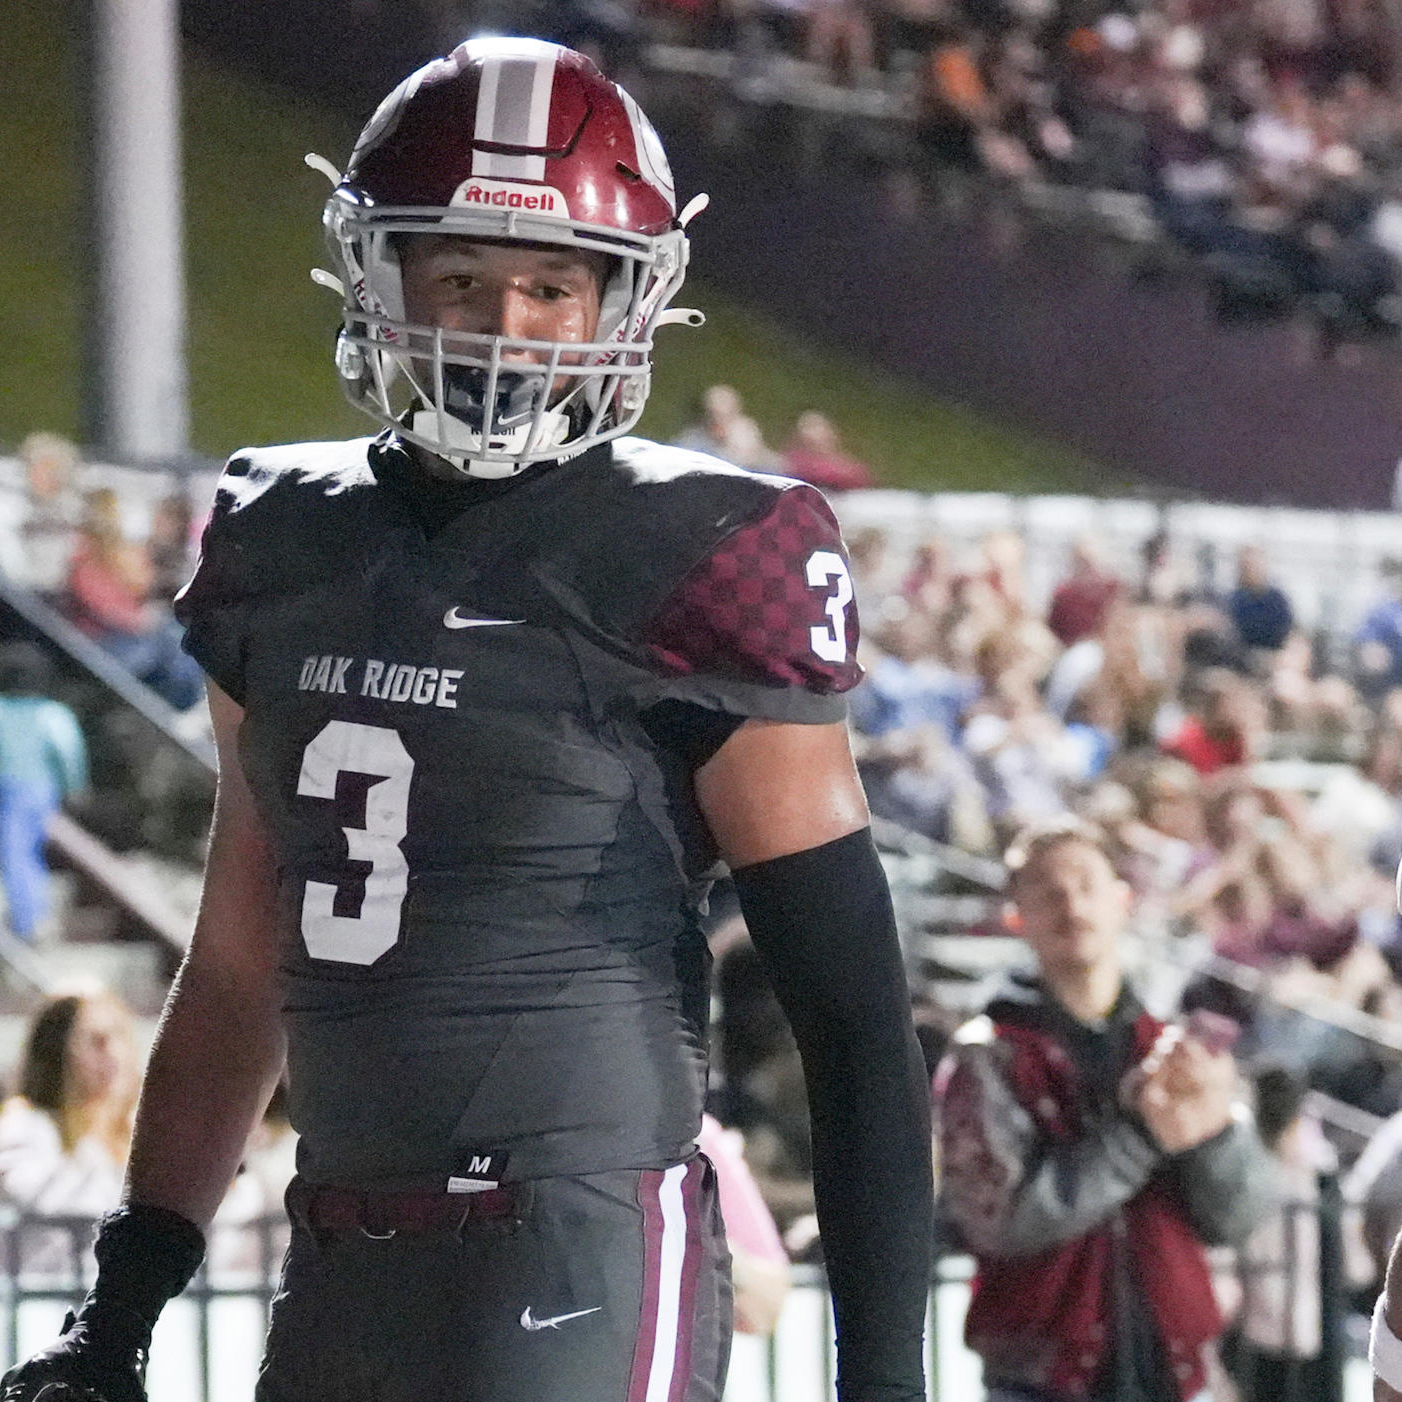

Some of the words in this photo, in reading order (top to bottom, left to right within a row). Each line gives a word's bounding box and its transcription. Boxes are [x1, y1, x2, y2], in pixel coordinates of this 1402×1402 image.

[465, 186, 554, 210] Riddell
[805, 551, 853, 663] 3
[299, 655, 353, 693] OAK
[360, 659, 465, 709] RIDGE
[297, 720, 415, 966] 3
[468, 1156, 491, 1173] M
